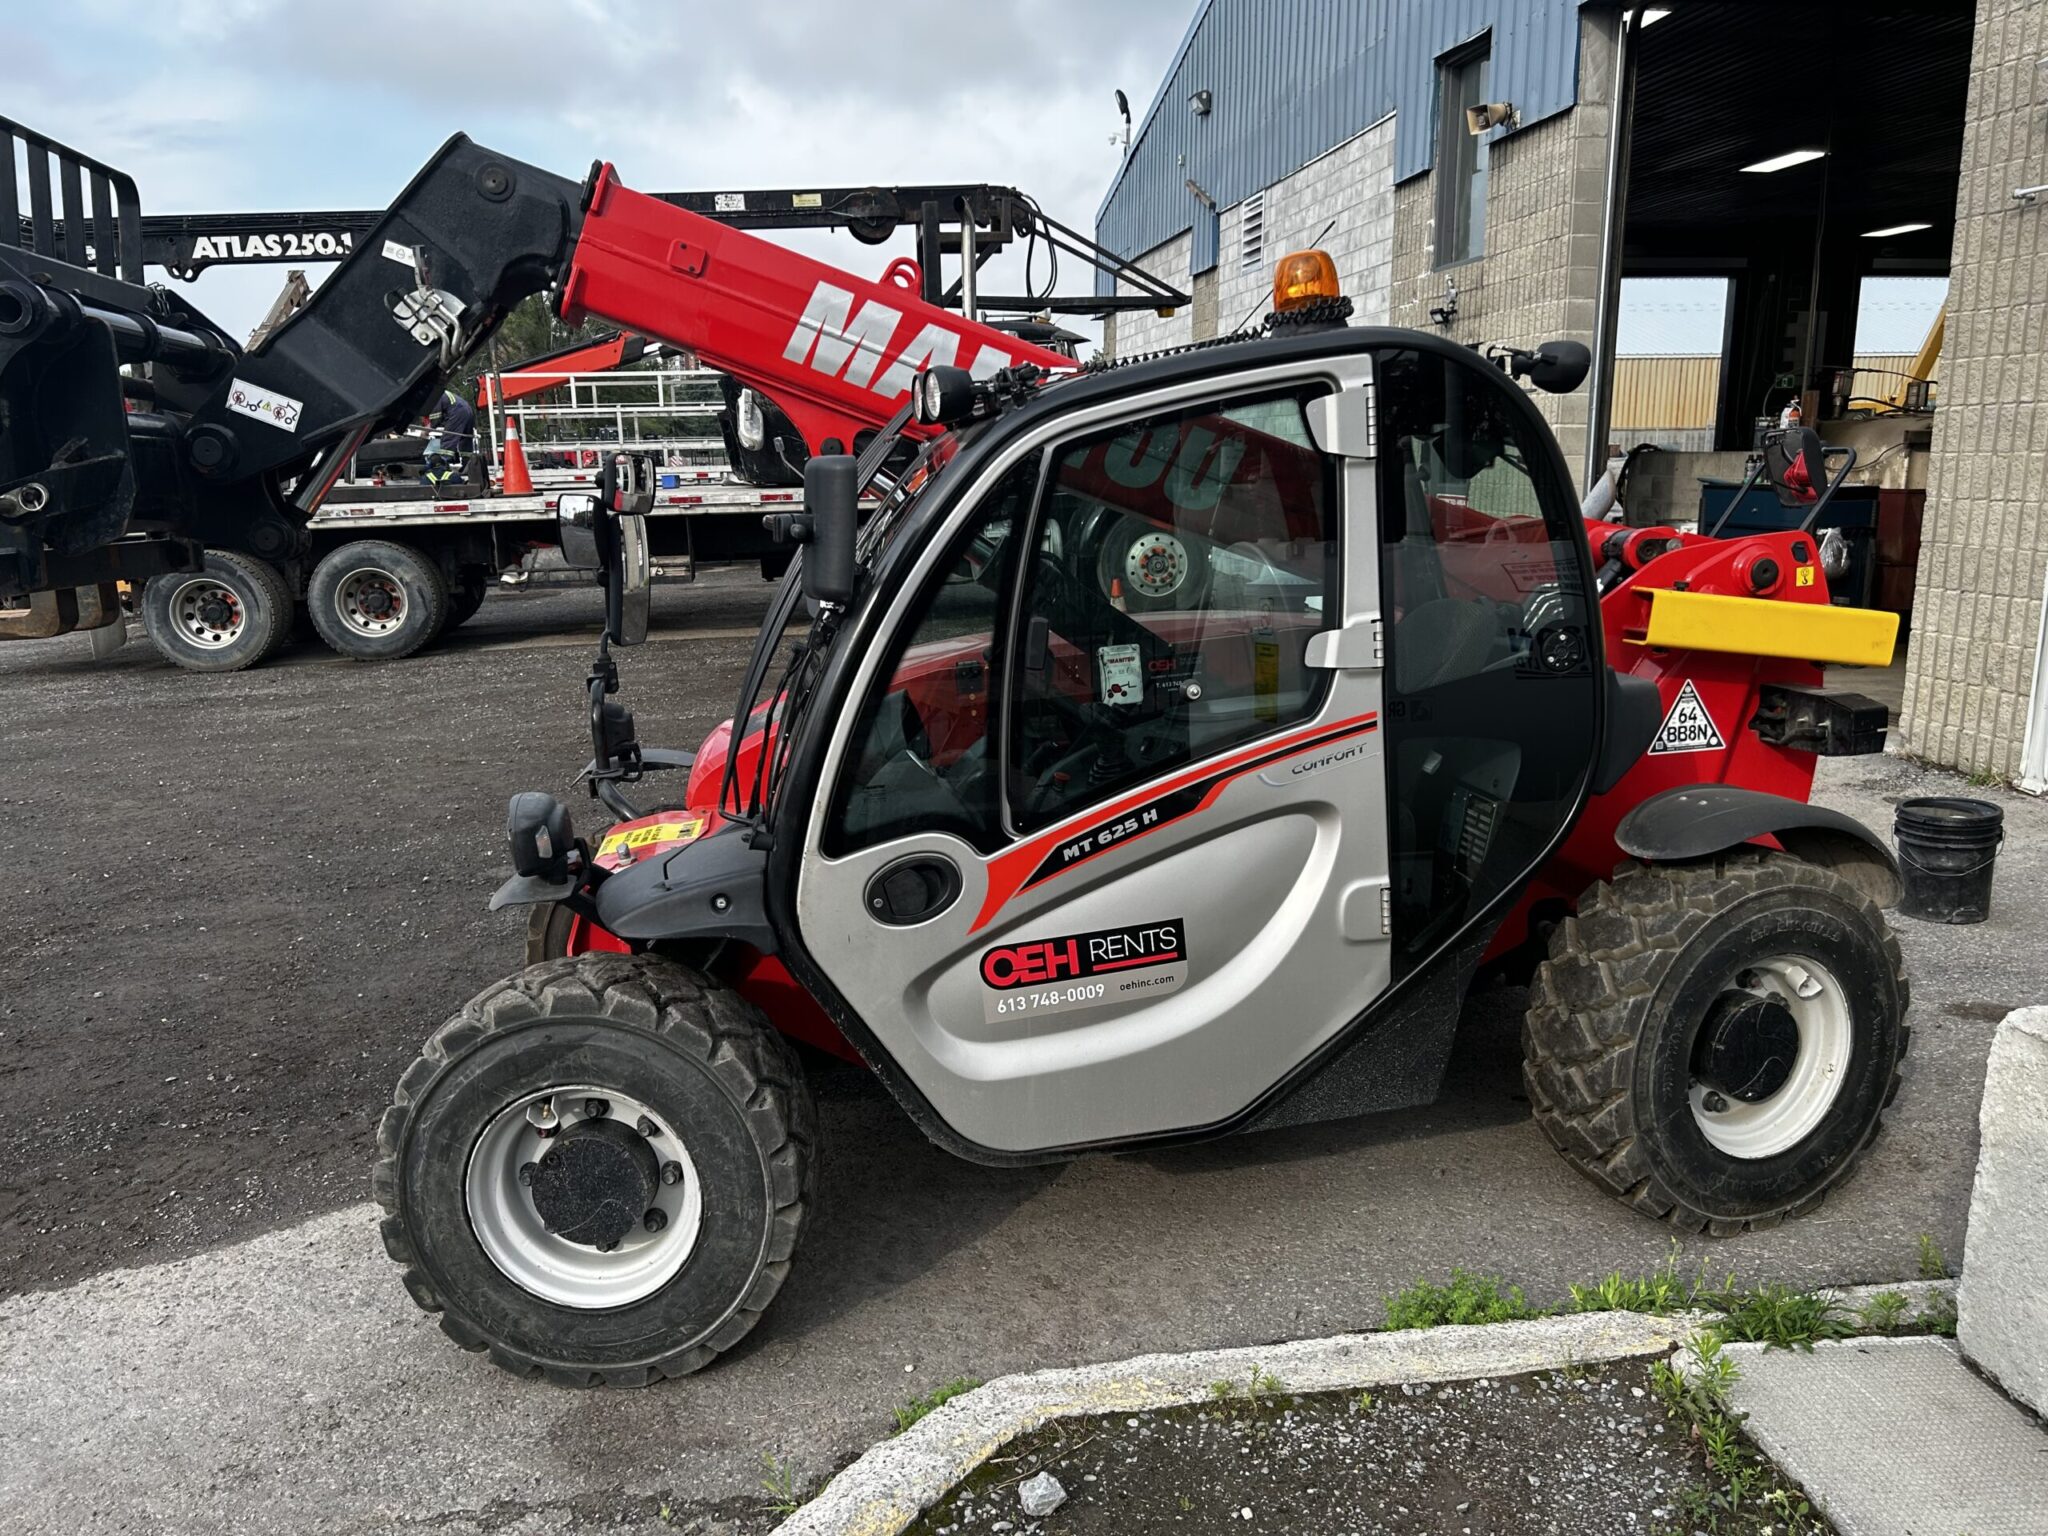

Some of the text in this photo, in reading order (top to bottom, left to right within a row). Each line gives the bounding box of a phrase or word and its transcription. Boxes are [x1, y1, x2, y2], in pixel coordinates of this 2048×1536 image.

[1678, 706, 1698, 724] 64
[1667, 723, 1708, 743] BB8N
[1291, 742, 1367, 775] COMFORT
[1063, 808, 1158, 862] MT 625 H
[984, 926, 1177, 987] OEH RENTS
[1119, 973, 1175, 991] oehinc.com
[997, 983, 1105, 1014] 613 748-0009
